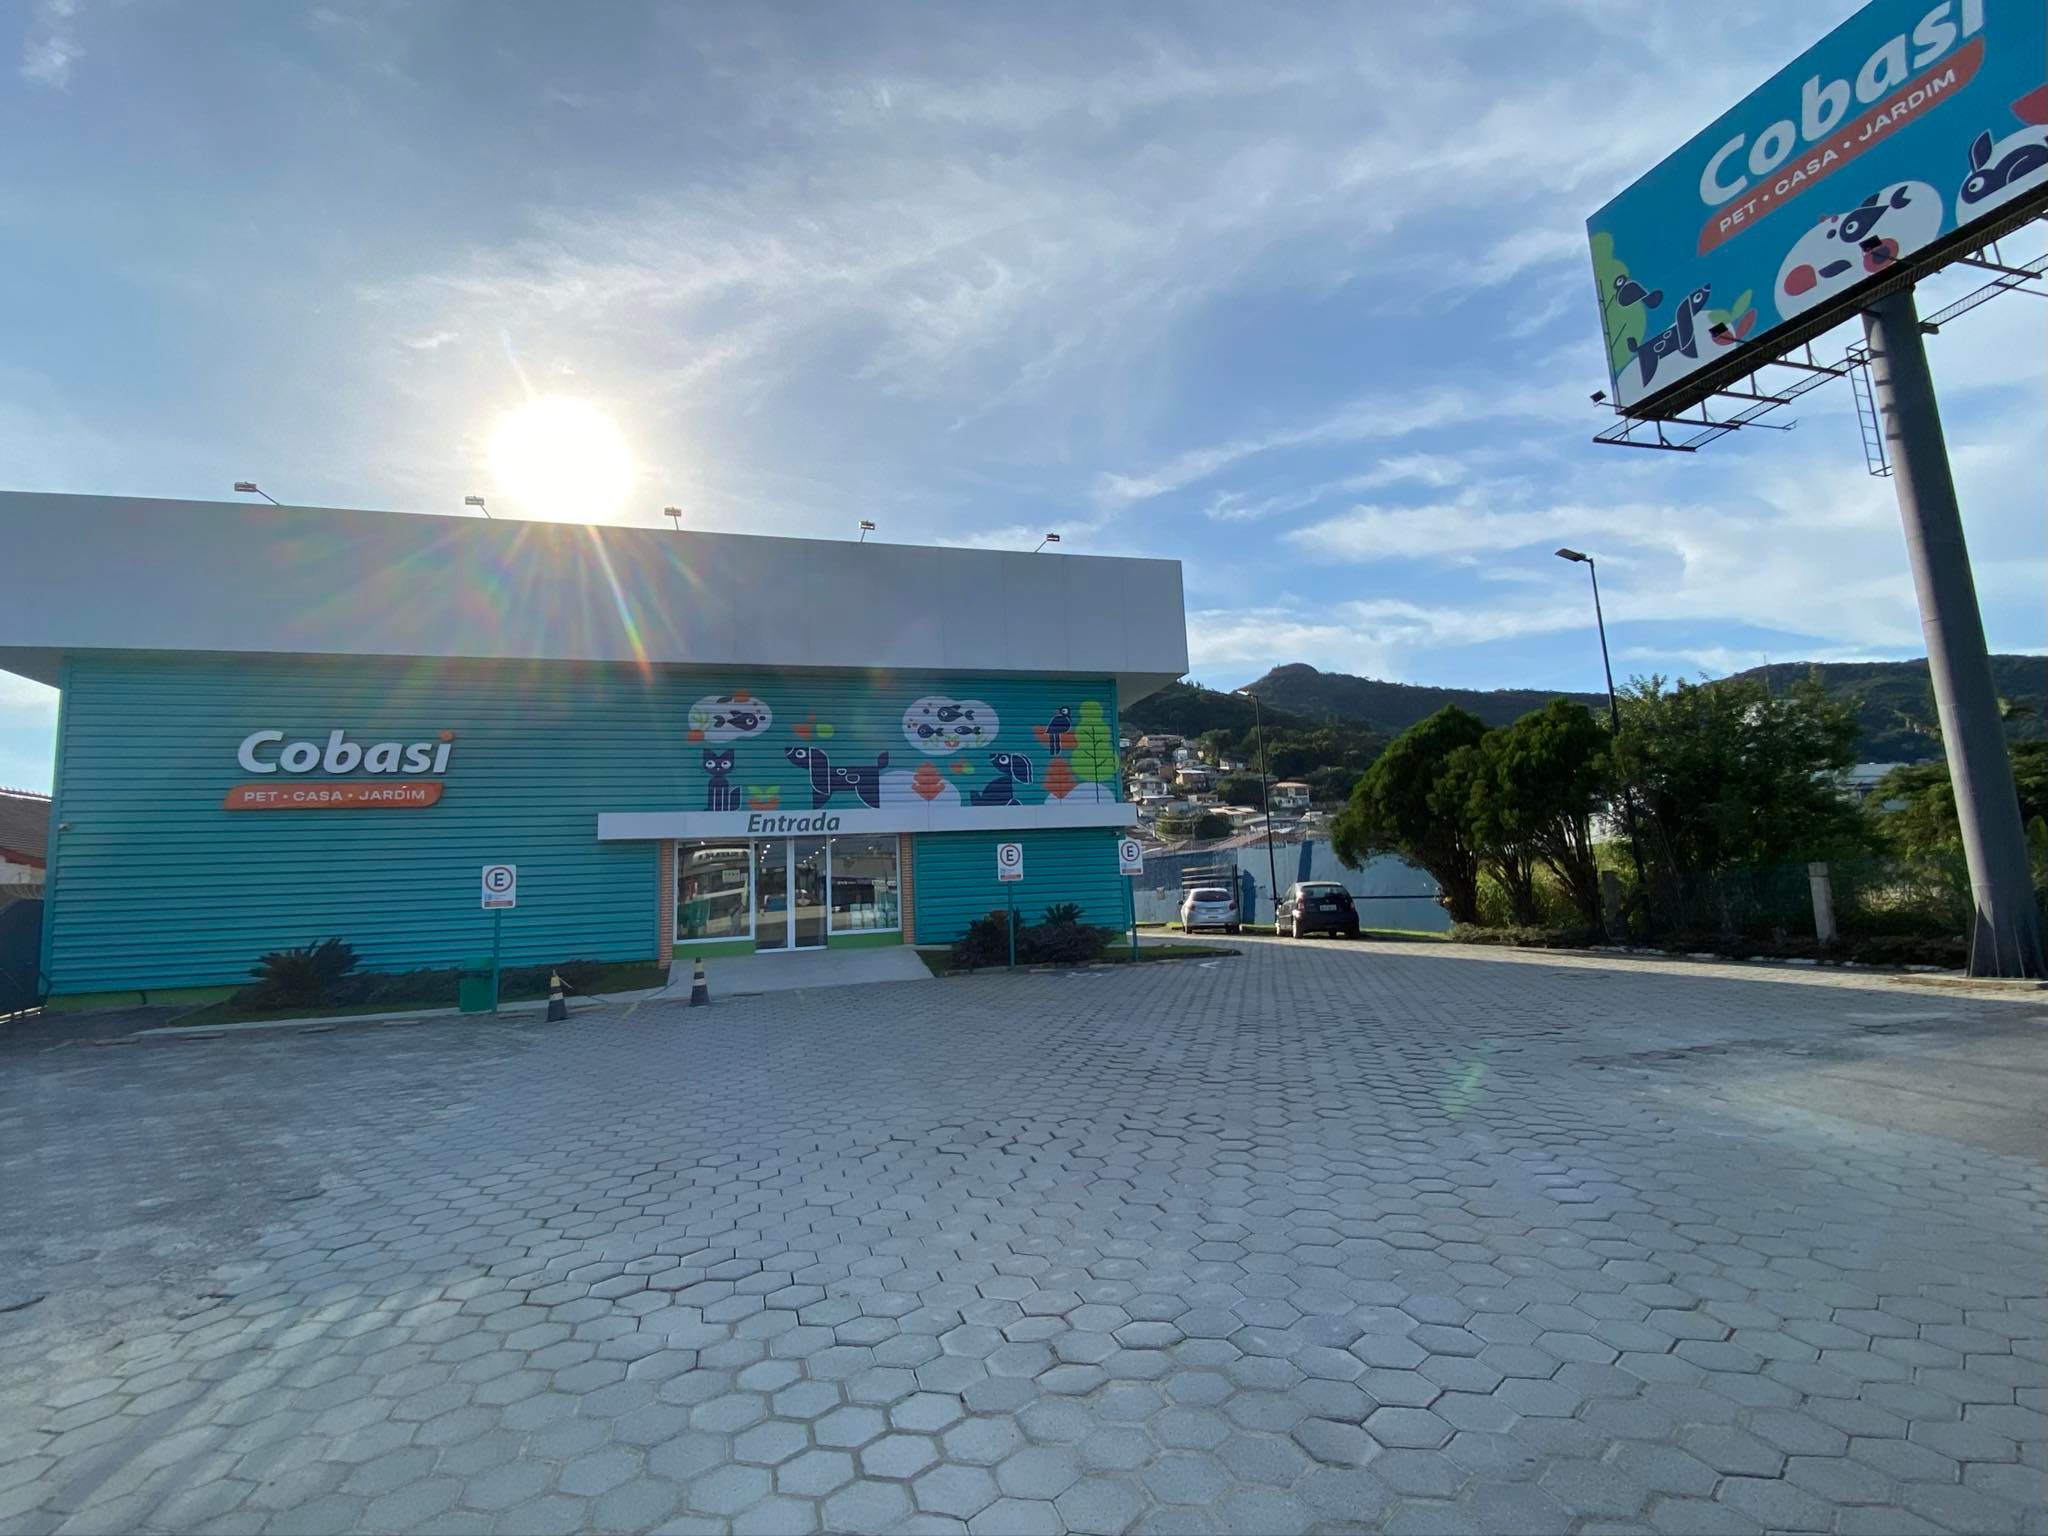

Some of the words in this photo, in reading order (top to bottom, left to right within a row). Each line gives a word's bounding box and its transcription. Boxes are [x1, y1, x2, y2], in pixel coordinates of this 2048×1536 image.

[1699, 0, 1985, 207] Cobasi
[1719, 201, 1757, 234] PET
[1774, 150, 1839, 196] CASA
[1858, 68, 1957, 142] JARDIM
[237, 729, 455, 774] Cobasi
[244, 791, 278, 802] PET
[293, 790, 343, 802] CASA
[359, 789, 426, 801] JARDIM
[747, 811, 841, 833] Entrada
[1006, 849, 1014, 862] E
[1127, 845, 1134, 858] E
[494, 872, 505, 887] E
